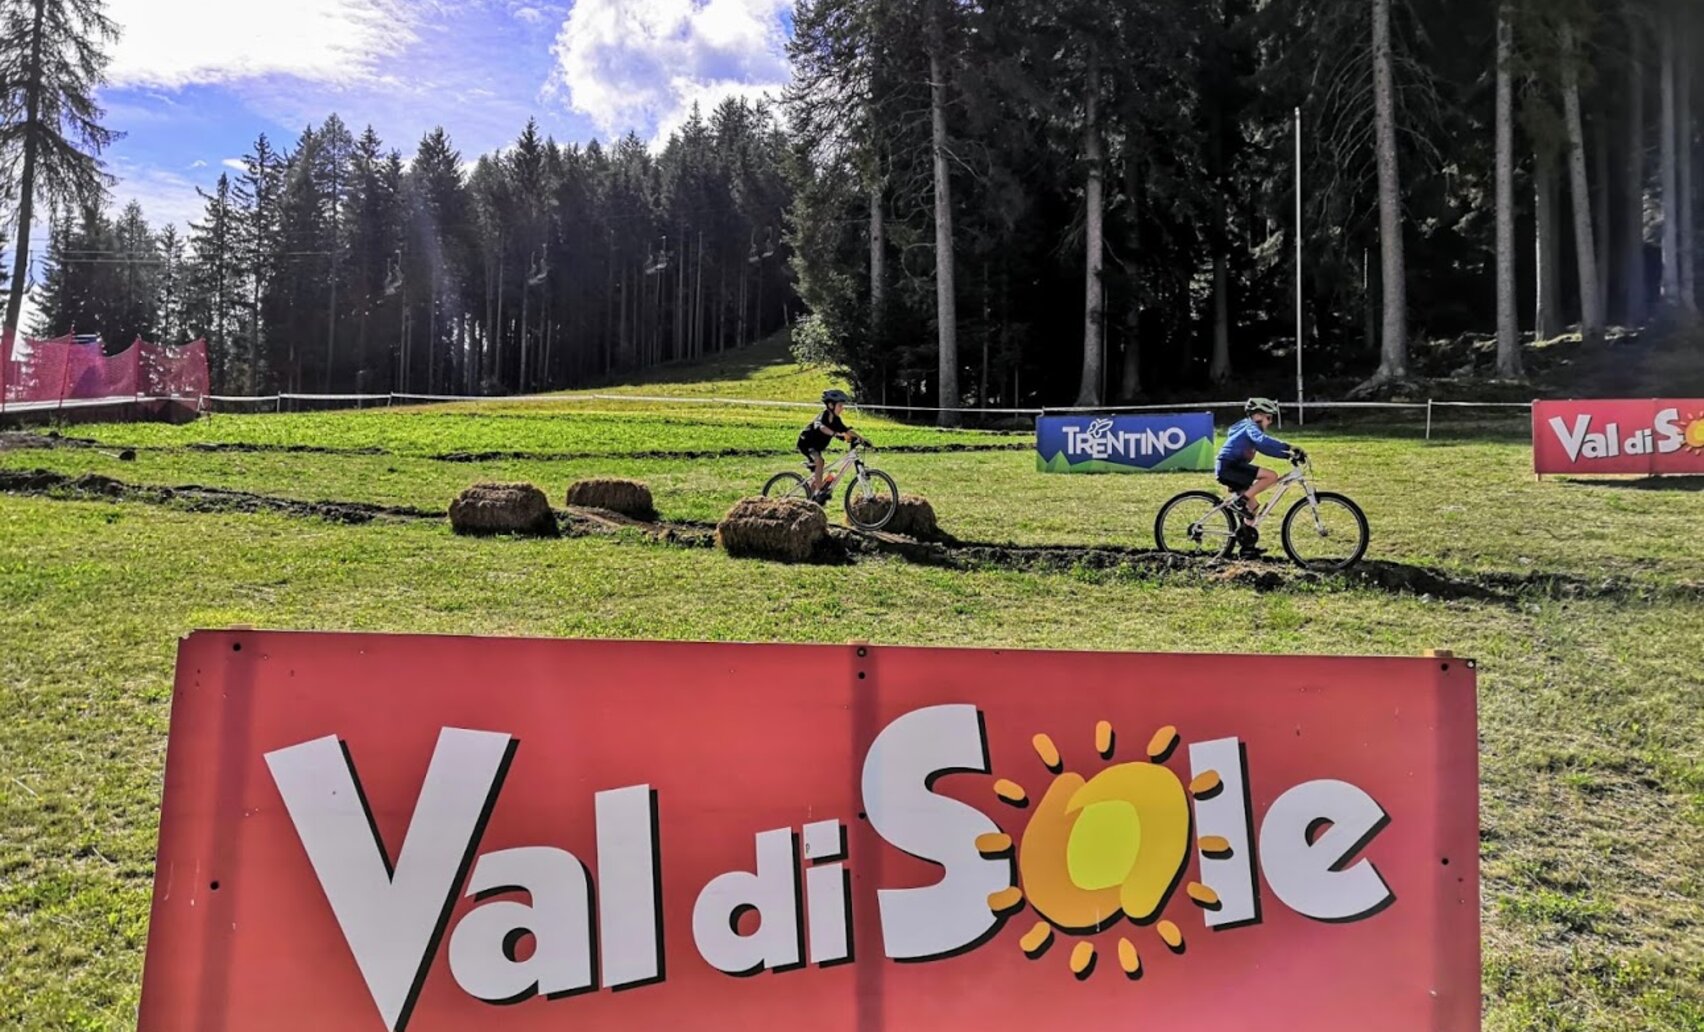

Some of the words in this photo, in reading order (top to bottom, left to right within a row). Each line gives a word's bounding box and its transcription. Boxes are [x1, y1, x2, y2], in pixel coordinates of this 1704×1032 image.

[1061, 426, 1187, 459] TRENTINO
[1548, 413, 1620, 464] Val
[1624, 427, 1654, 455] di
[263, 726, 667, 1032] Val
[692, 818, 855, 977] di
[861, 703, 1398, 968] Sole
